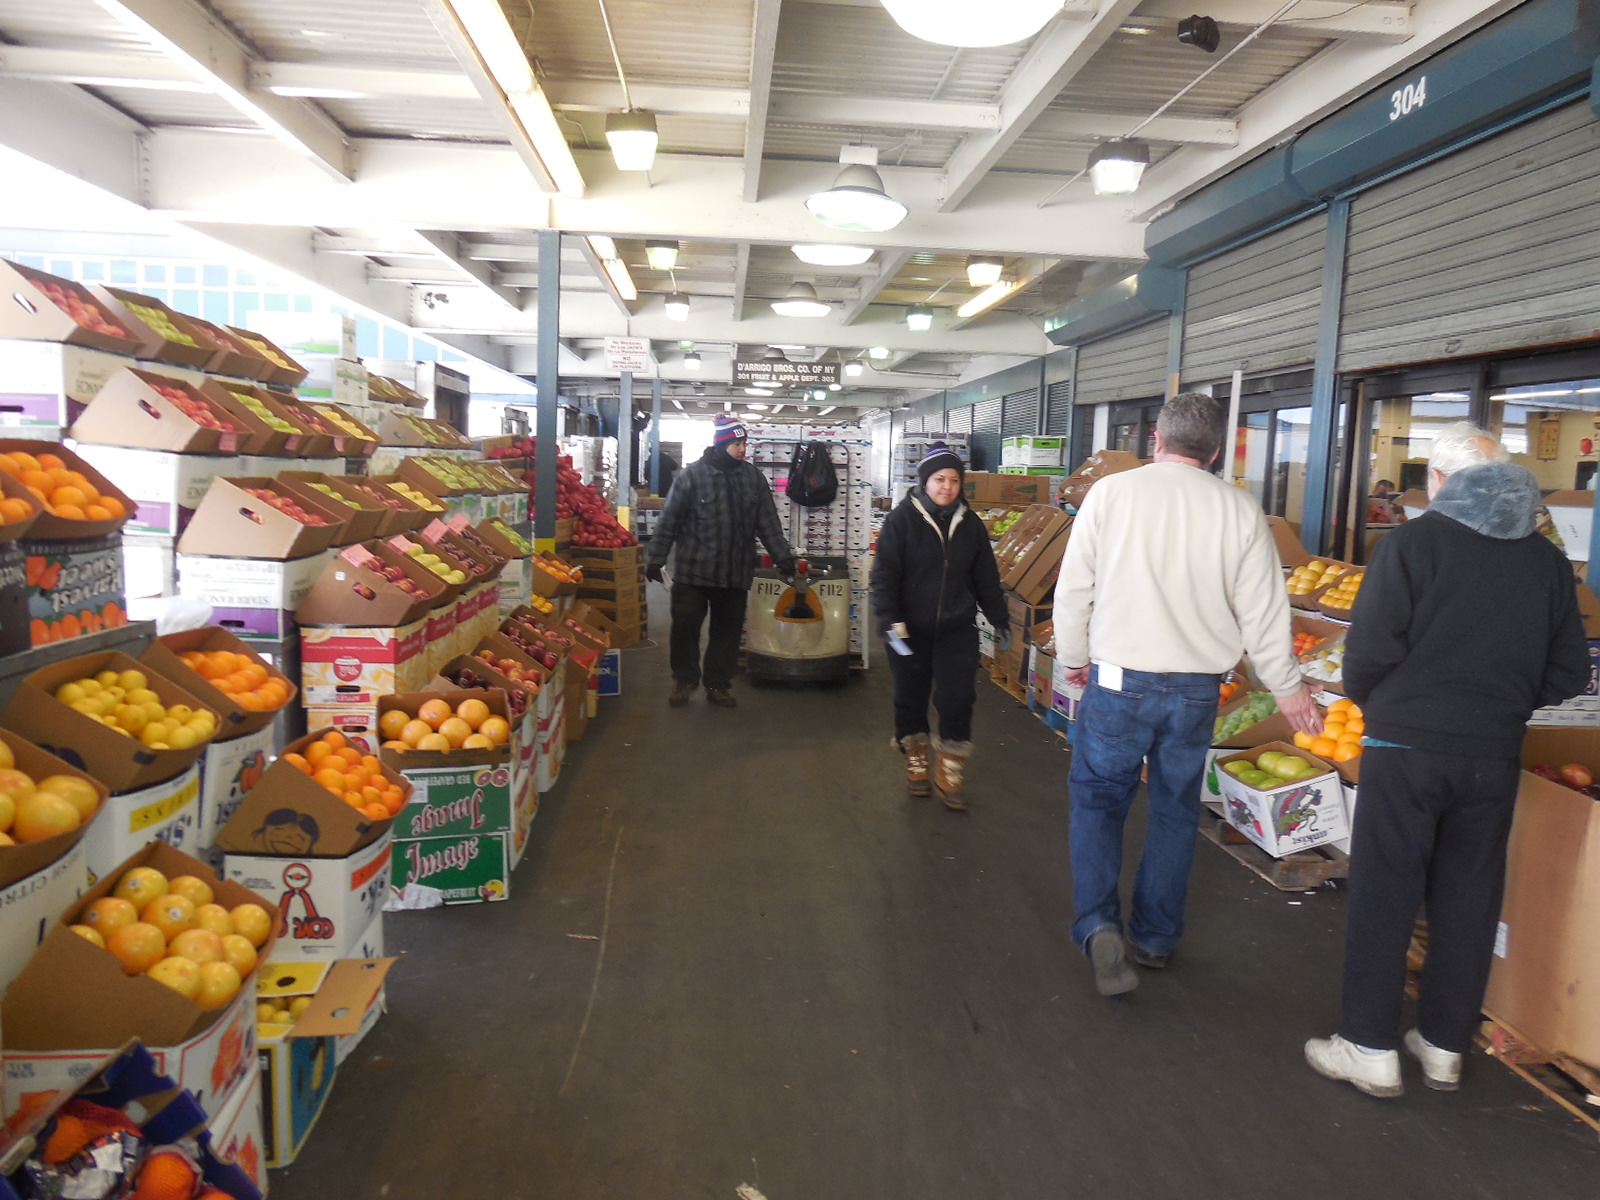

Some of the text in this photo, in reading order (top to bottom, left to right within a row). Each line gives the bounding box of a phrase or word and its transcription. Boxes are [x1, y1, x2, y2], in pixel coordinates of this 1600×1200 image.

[1389, 76, 1426, 120] 304
[737, 362, 836, 374] D'ARRIGO BROS. CO. OF NY
[736, 372, 750, 380] 301
[757, 583, 781, 595] F112
[820, 584, 842, 596] F112
[456, 774, 471, 785] RED
[410, 788, 486, 836] Image
[404, 837, 480, 884] Image
